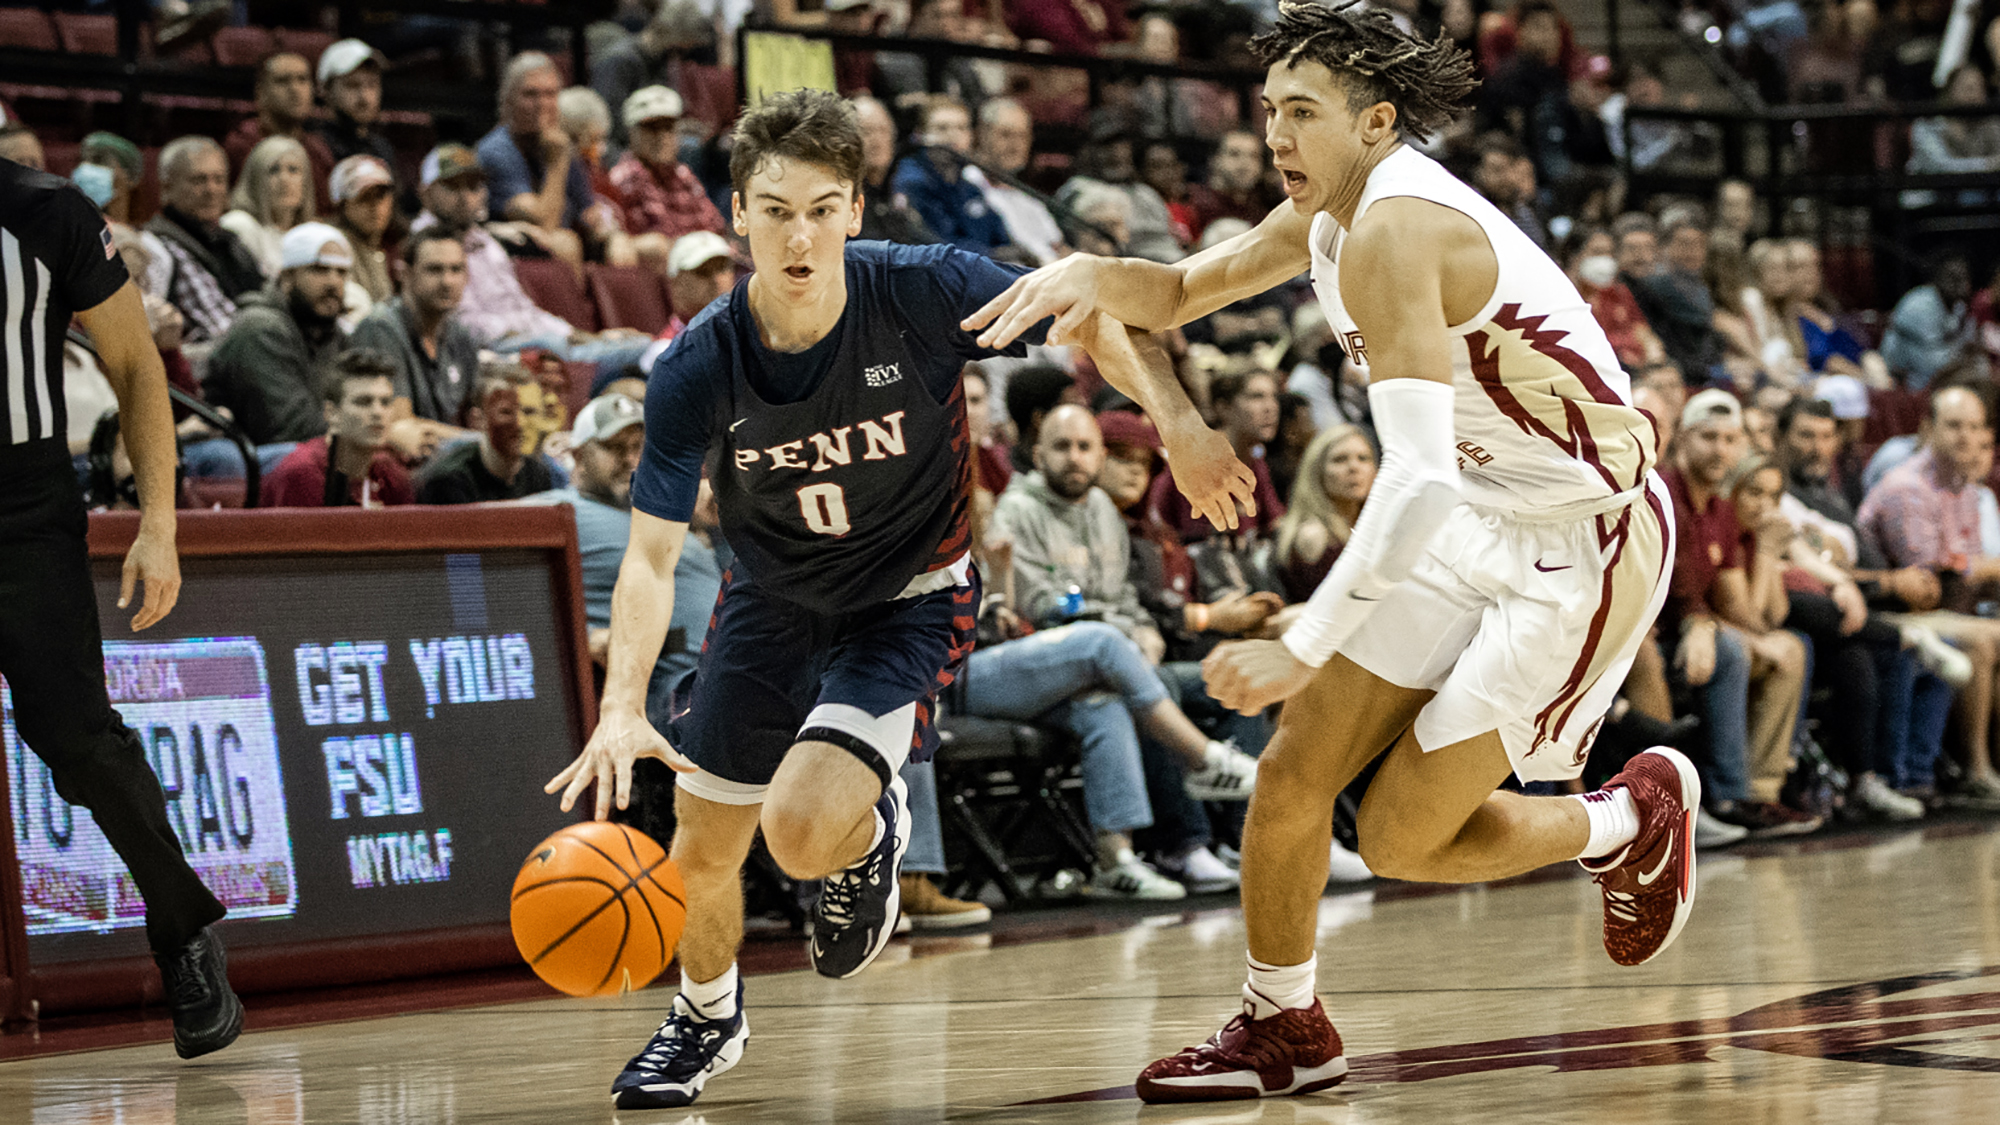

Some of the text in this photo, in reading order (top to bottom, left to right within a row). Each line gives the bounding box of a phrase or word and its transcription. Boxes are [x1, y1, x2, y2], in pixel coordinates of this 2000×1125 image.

[874, 362, 899, 381] IVY
[734, 410, 907, 472] PENN
[796, 482, 852, 537] 0
[294, 633, 535, 726] GET YOUR
[124, 720, 254, 855] RAG
[321, 732, 424, 820] FSU
